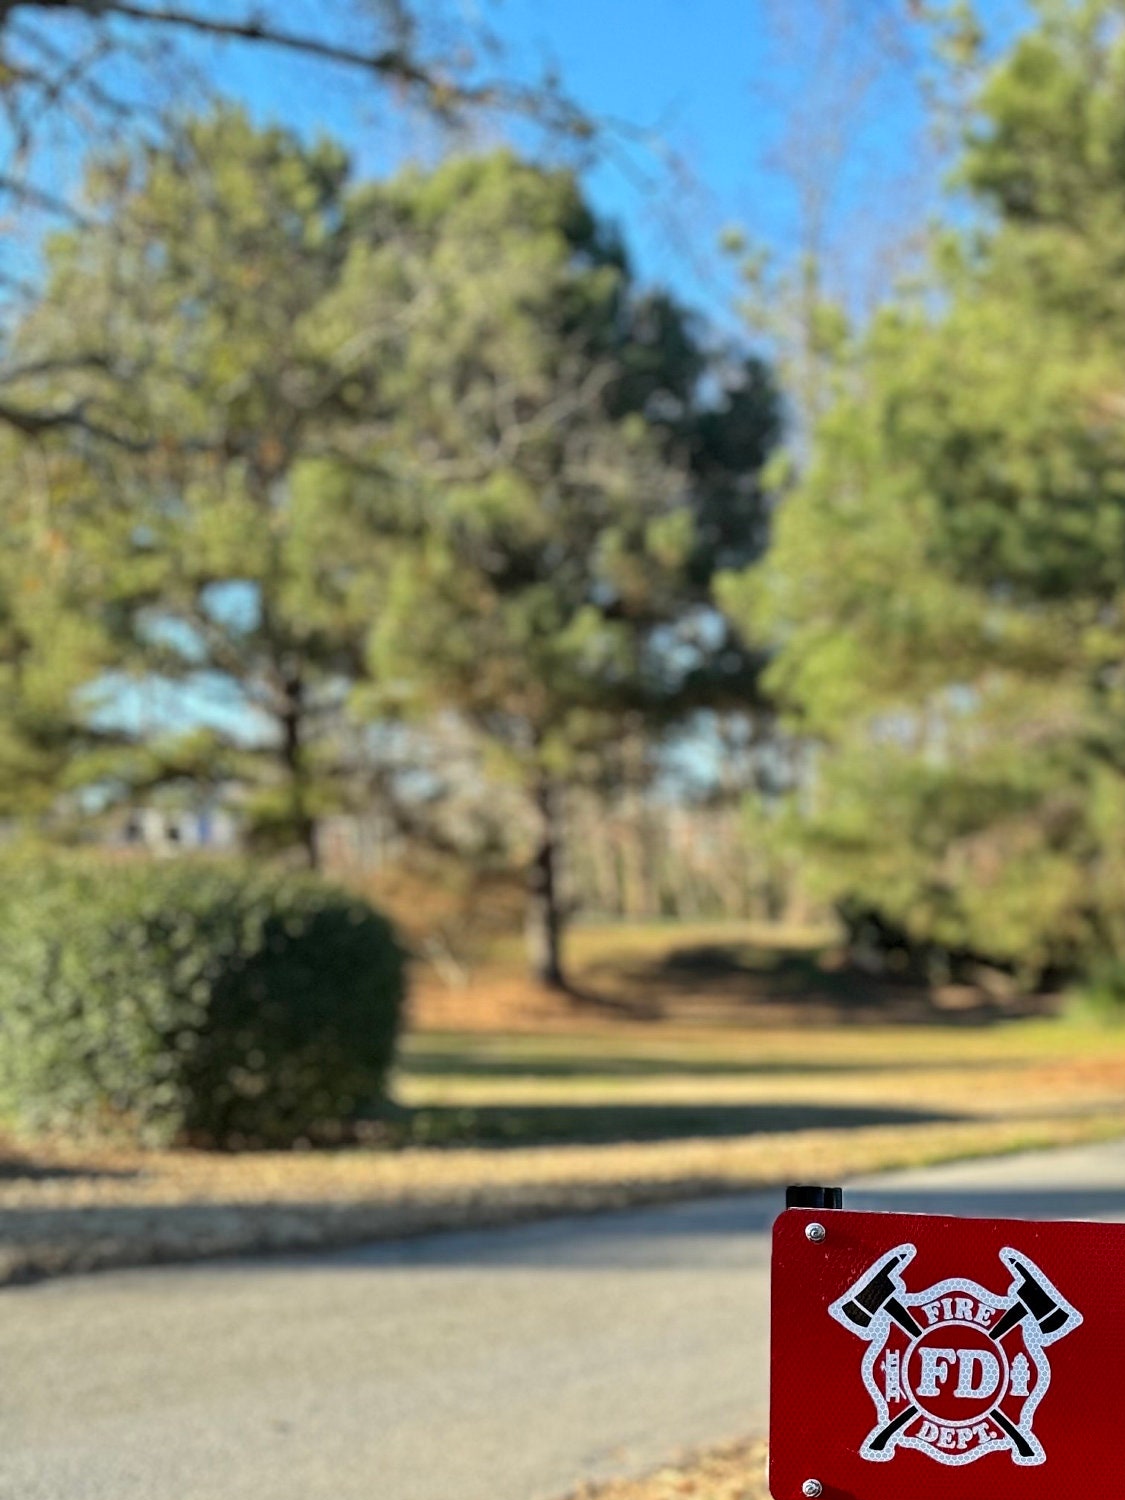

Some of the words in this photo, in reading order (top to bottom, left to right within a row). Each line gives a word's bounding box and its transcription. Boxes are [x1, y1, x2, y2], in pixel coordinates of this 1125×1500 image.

[922, 1298, 995, 1326] FIRE
[916, 1347, 1000, 1398] FD
[916, 1421, 997, 1449] DEPT.
